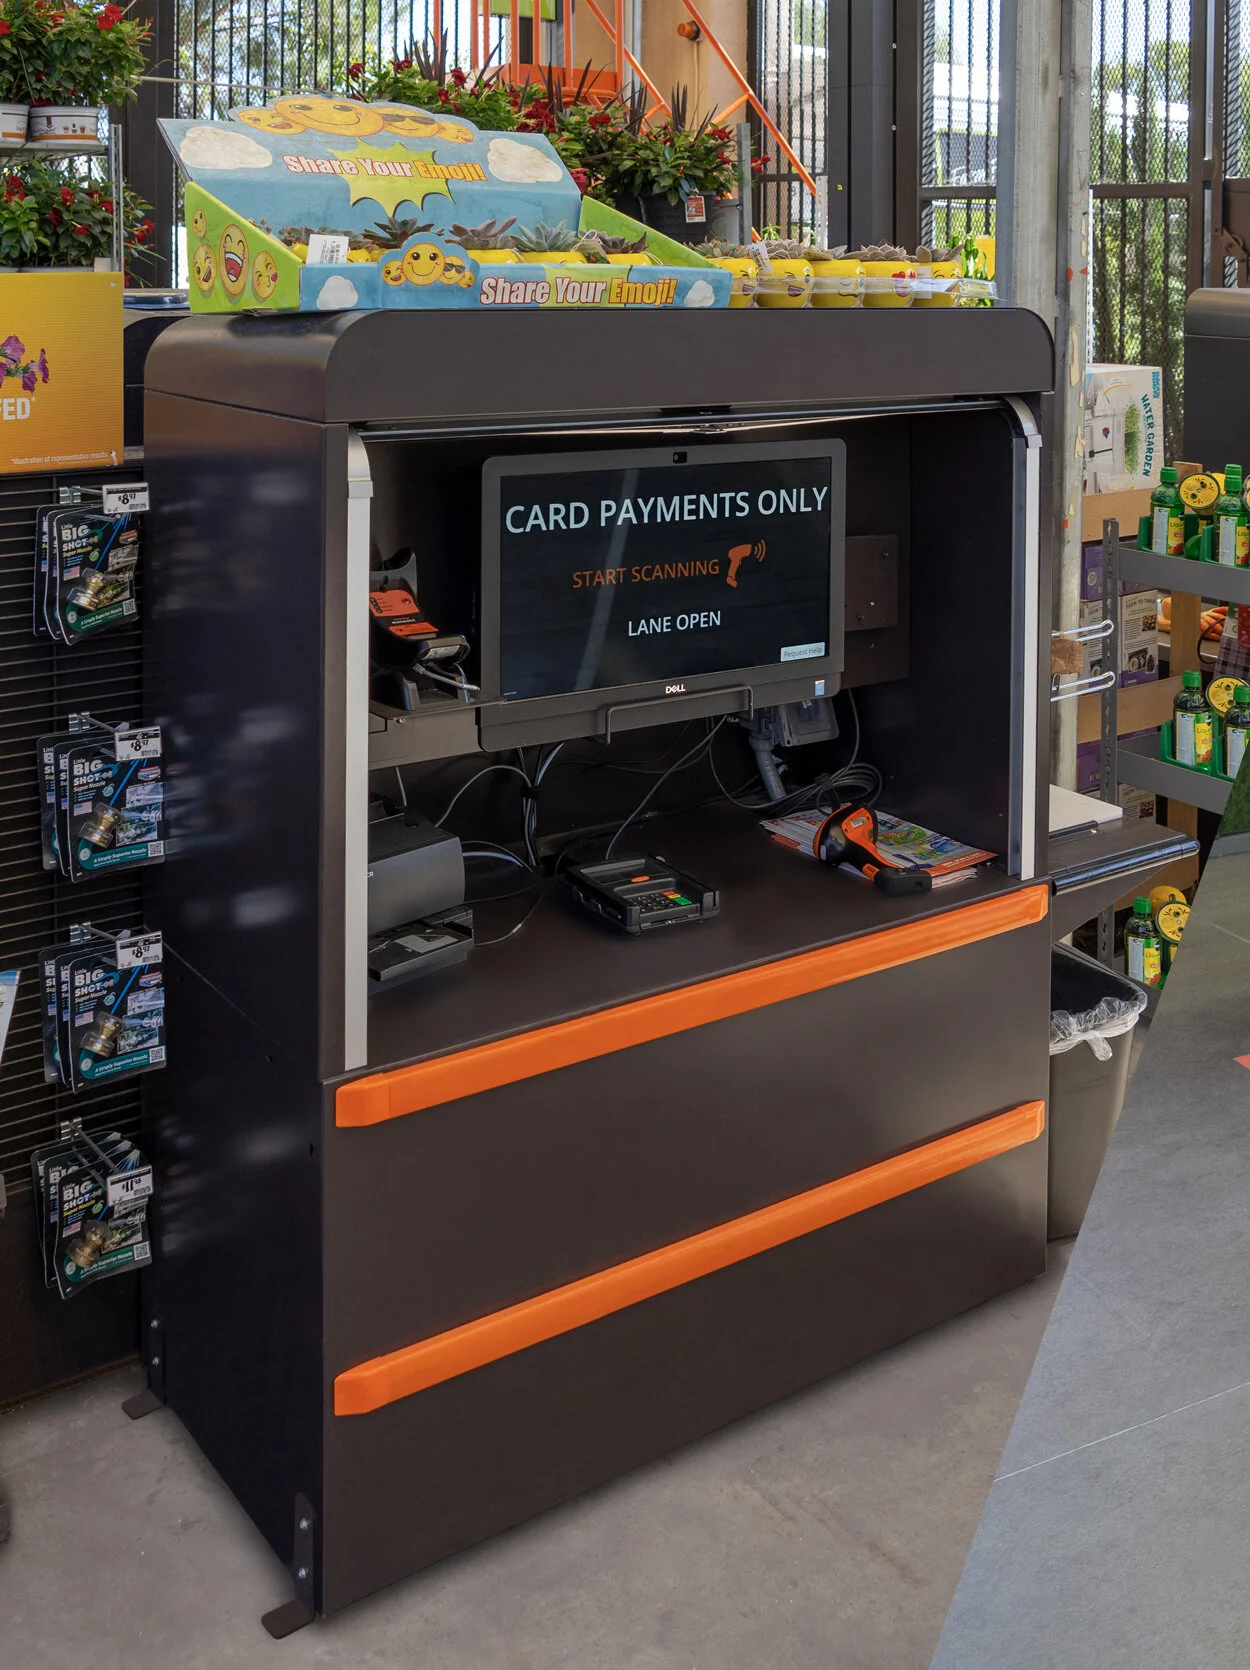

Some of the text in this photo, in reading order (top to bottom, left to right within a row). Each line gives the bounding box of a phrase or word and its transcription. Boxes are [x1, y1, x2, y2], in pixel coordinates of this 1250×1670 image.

[282, 155, 488, 182] Share Your Emoji!
[480, 275, 679, 307] Share Your Emoji!
[1141, 393, 1155, 477] WATER GARDEN
[505, 486, 829, 534] CARD PAYMENTS ONLY
[62, 524, 90, 542] BIG
[77, 546, 92, 554] Nozzle
[572, 558, 721, 589] START SCANNING
[628, 610, 722, 637] LANE OPEN
[783, 646, 824, 660] Request Help
[665, 684, 686, 695] DELL
[73, 760, 103, 776] BIG
[88, 780, 106, 789] Nozzle
[74, 968, 104, 986] BIG
[75, 990, 108, 1003] Super Nozzle
[99, 1064, 113, 1073] Simply
[133, 1054, 148, 1063] Nozzle
[63, 1181, 94, 1201] BIG
[63, 1200, 96, 1216] Super Nozzle
